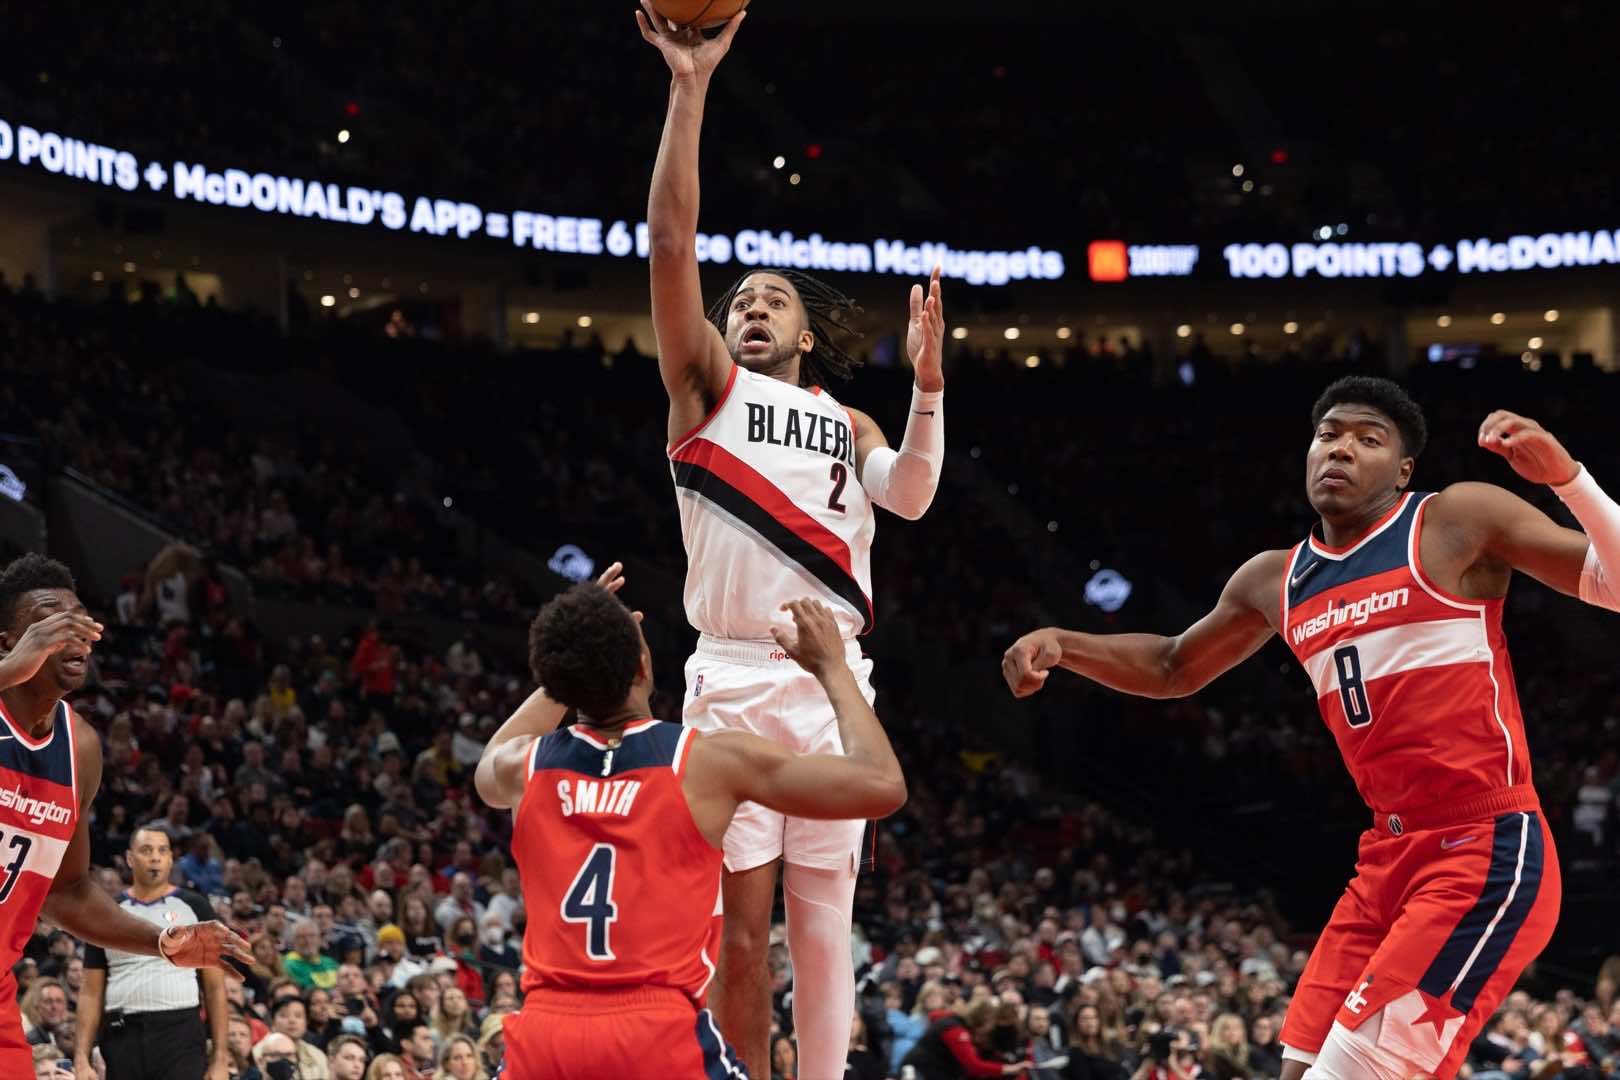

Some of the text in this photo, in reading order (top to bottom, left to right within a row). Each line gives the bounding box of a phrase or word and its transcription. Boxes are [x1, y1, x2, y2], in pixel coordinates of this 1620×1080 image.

[18, 125, 138, 191] POINTS
[173, 161, 406, 230] McDONALD'S
[411, 197, 482, 239] APP
[513, 211, 603, 254] FREE
[606, 221, 633, 257] 6
[735, 230, 872, 272] Chicken
[874, 238, 1065, 286] McNuggets
[1224, 243, 1290, 278] 100
[1292, 242, 1425, 278] POINTS
[827, 462, 847, 514] 2
[1333, 644, 1372, 729] 8
[0, 783, 72, 825] shington
[557, 779, 641, 817] SMITH
[0, 830, 32, 904] 3
[560, 842, 618, 961] 4
